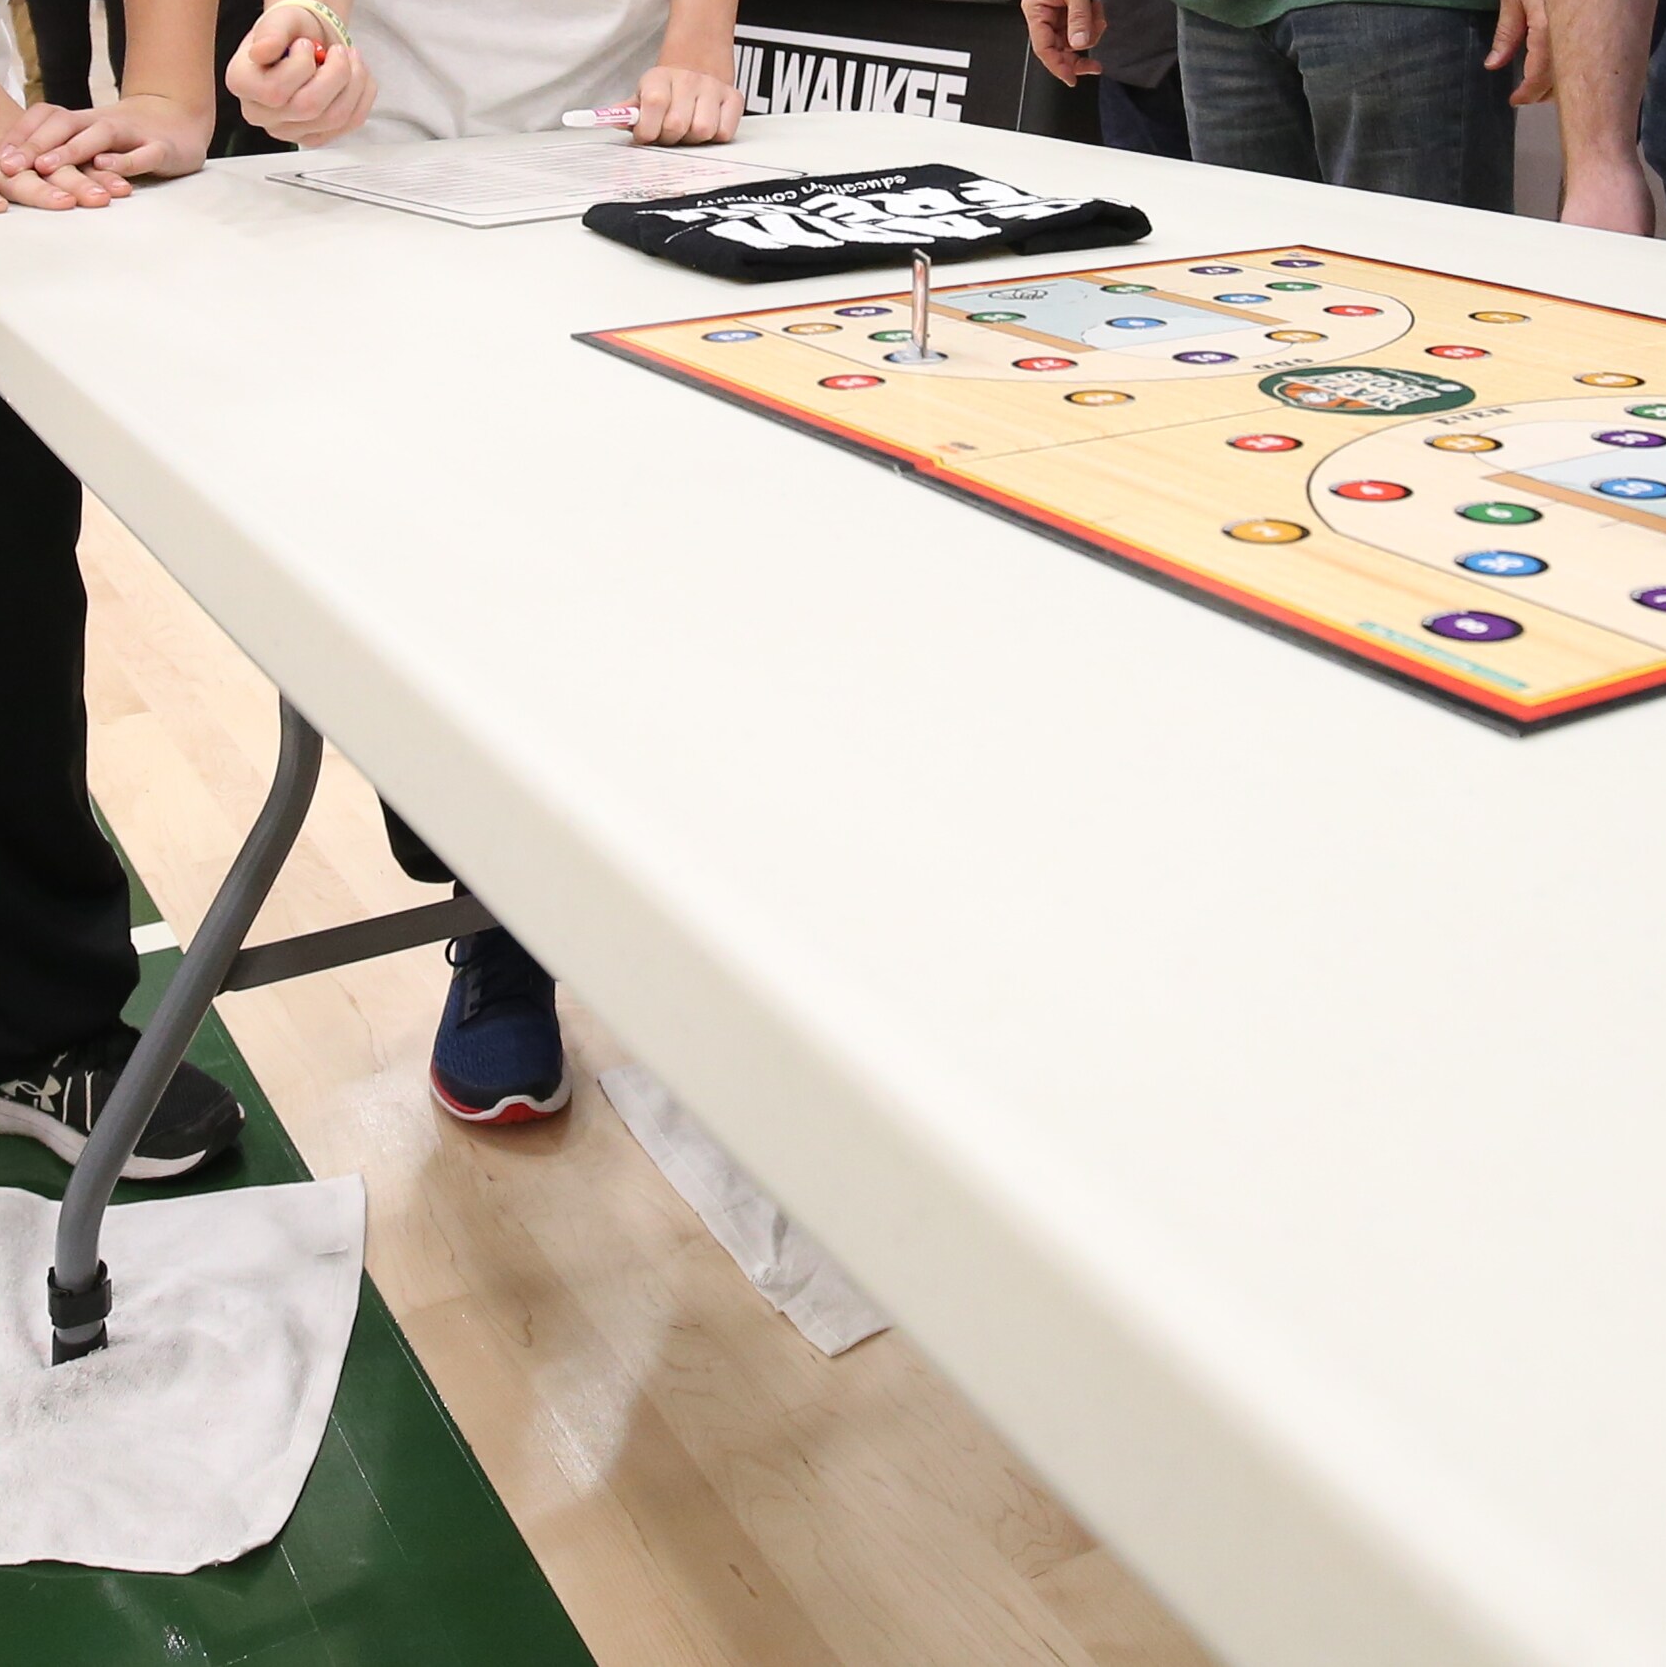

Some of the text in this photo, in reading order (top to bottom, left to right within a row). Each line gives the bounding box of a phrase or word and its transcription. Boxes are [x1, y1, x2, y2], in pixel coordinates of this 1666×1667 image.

[734, 44, 968, 122] ILWAUKEE
[800, 174, 907, 196] education
[1435, 407, 1514, 425] EVEN
[1455, 618, 1489, 634] 8
